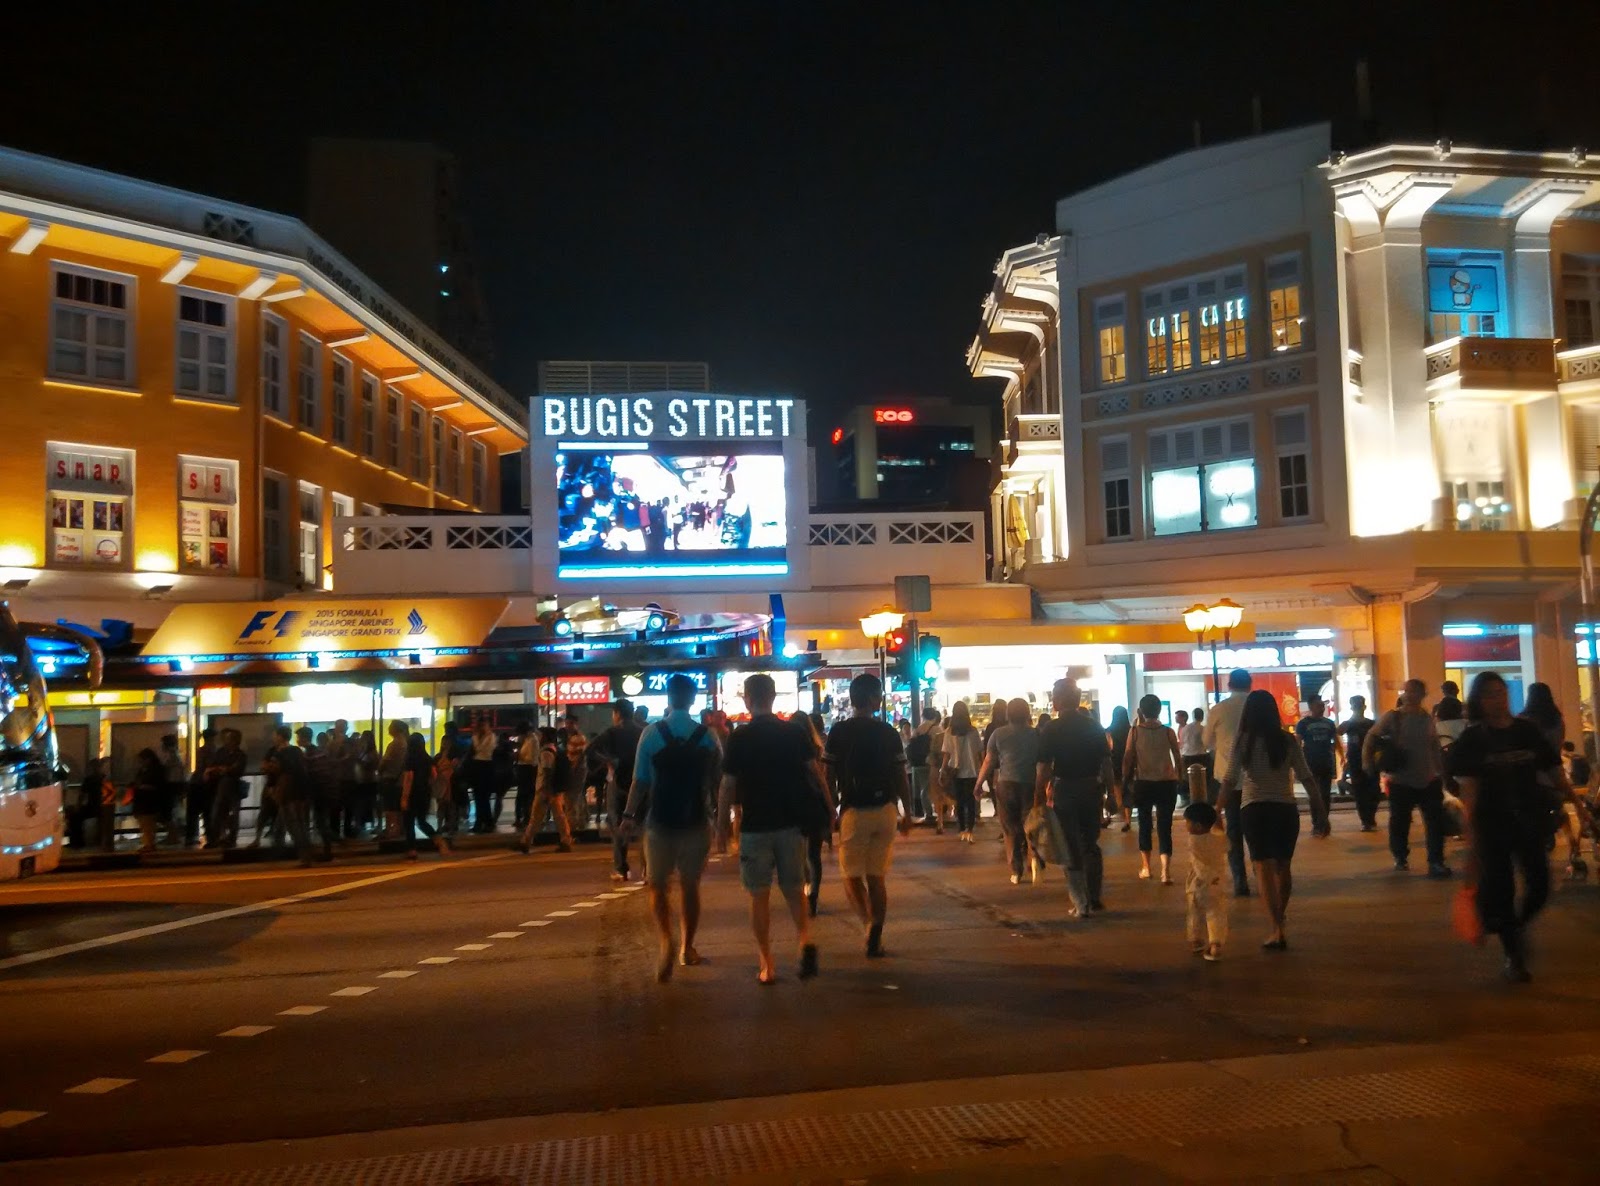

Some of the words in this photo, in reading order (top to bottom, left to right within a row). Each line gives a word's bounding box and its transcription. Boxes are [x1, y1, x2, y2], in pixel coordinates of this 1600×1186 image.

[1149, 313, 1180, 337] CAT
[1202, 298, 1244, 327] CAFE
[544, 398, 654, 437] BUGIS
[668, 398, 794, 437] STREET
[316, 609, 334, 618] 2015
[336, 609, 376, 617] FORMULA
[308, 619, 356, 628] SINGAPORE
[359, 618, 394, 626] AIRLINES
[301, 629, 350, 638] SINGAPORE
[351, 628, 382, 637] GRAND
[383, 628, 402, 636] PRIX
